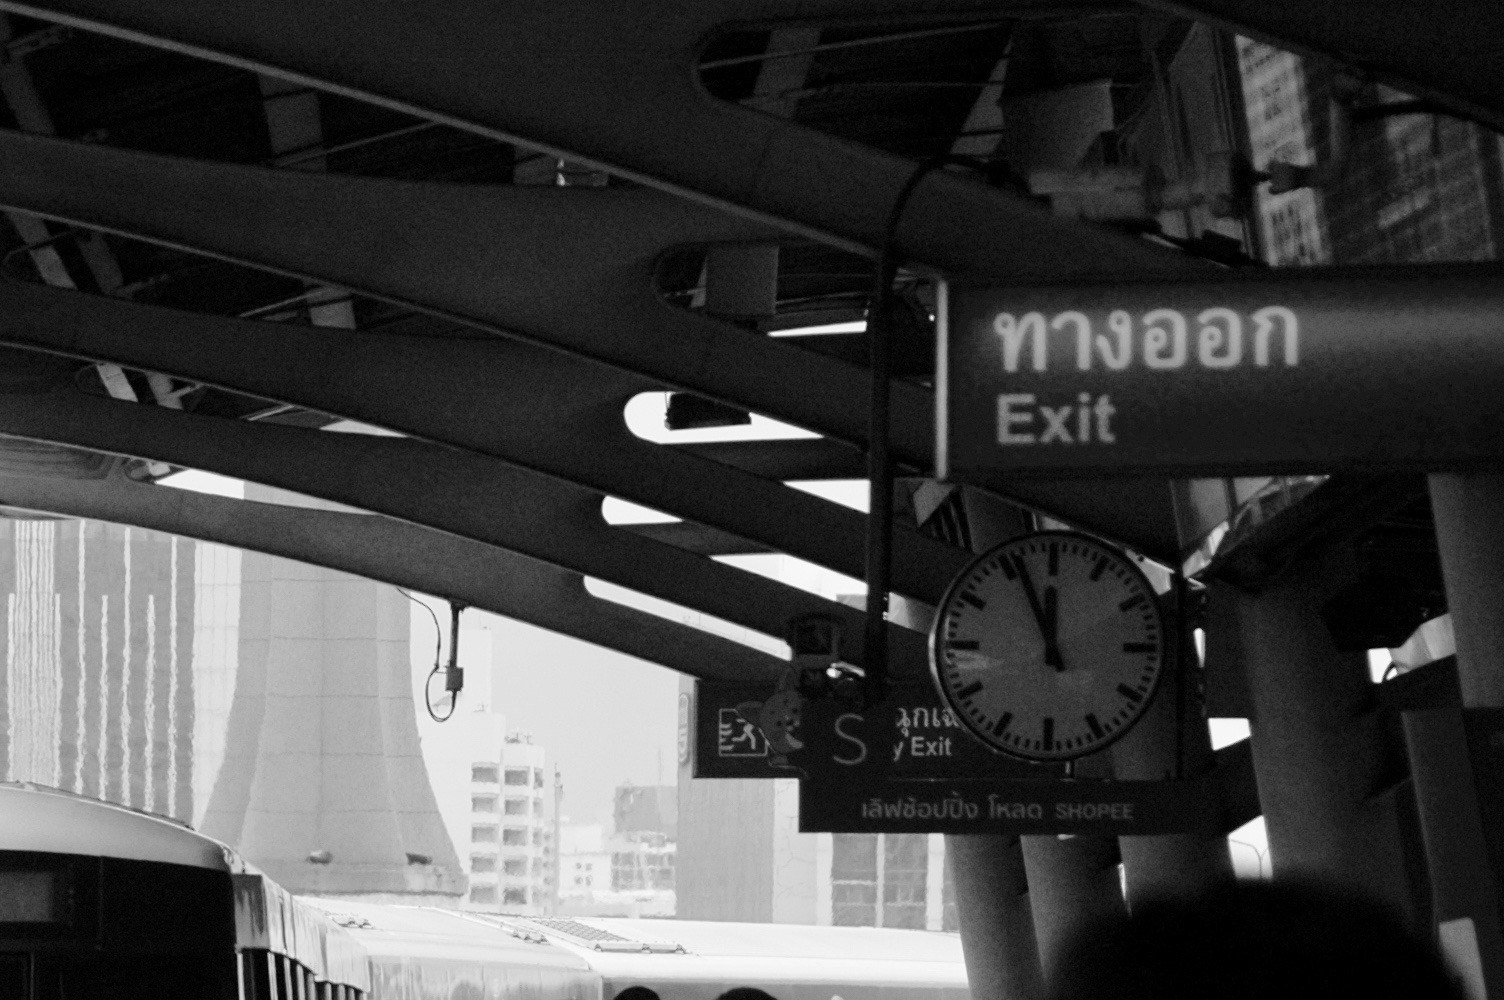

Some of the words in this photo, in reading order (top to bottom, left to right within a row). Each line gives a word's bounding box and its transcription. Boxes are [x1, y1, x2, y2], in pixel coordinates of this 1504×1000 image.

[994, 305, 1299, 373] ทางออก
[997, 391, 1117, 445] Exit
[911, 735, 952, 757] Exit
[1056, 803, 1134, 821] SHOPEE
